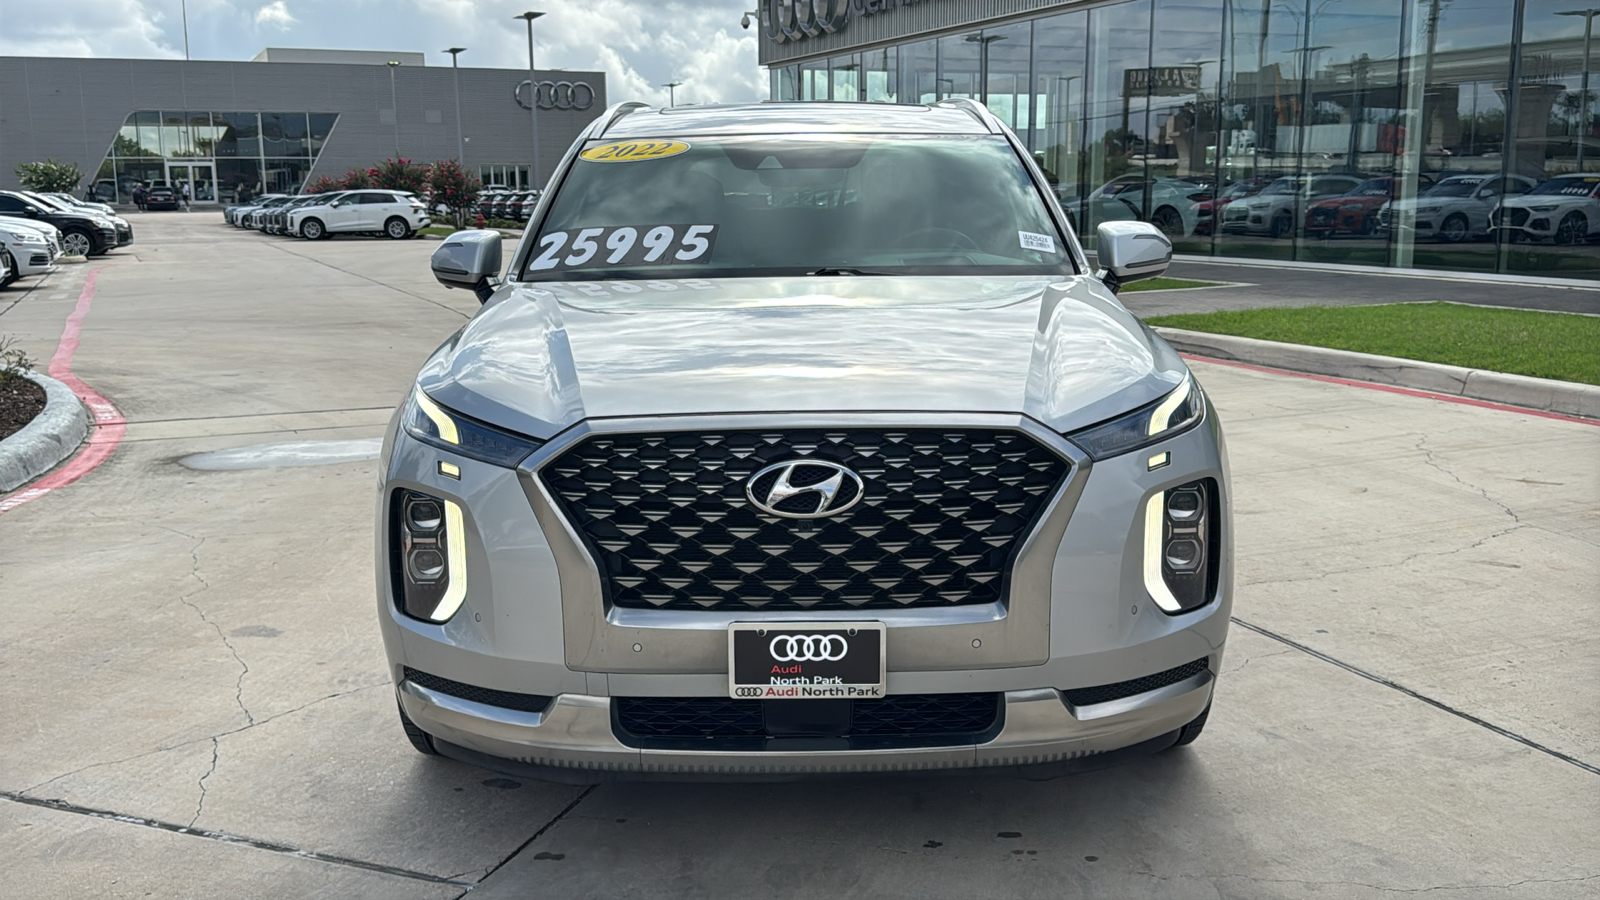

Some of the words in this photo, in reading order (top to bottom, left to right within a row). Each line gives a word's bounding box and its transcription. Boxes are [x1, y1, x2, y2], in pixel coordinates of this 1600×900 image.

[597, 142, 673, 159] 2022
[529, 225, 715, 271] 25995
[771, 665, 802, 673] Audi
[770, 676, 809, 685] North
[813, 676, 843, 685] Park
[765, 687, 798, 696] Audi
[802, 687, 844, 696] North
[847, 687, 879, 696] Park
